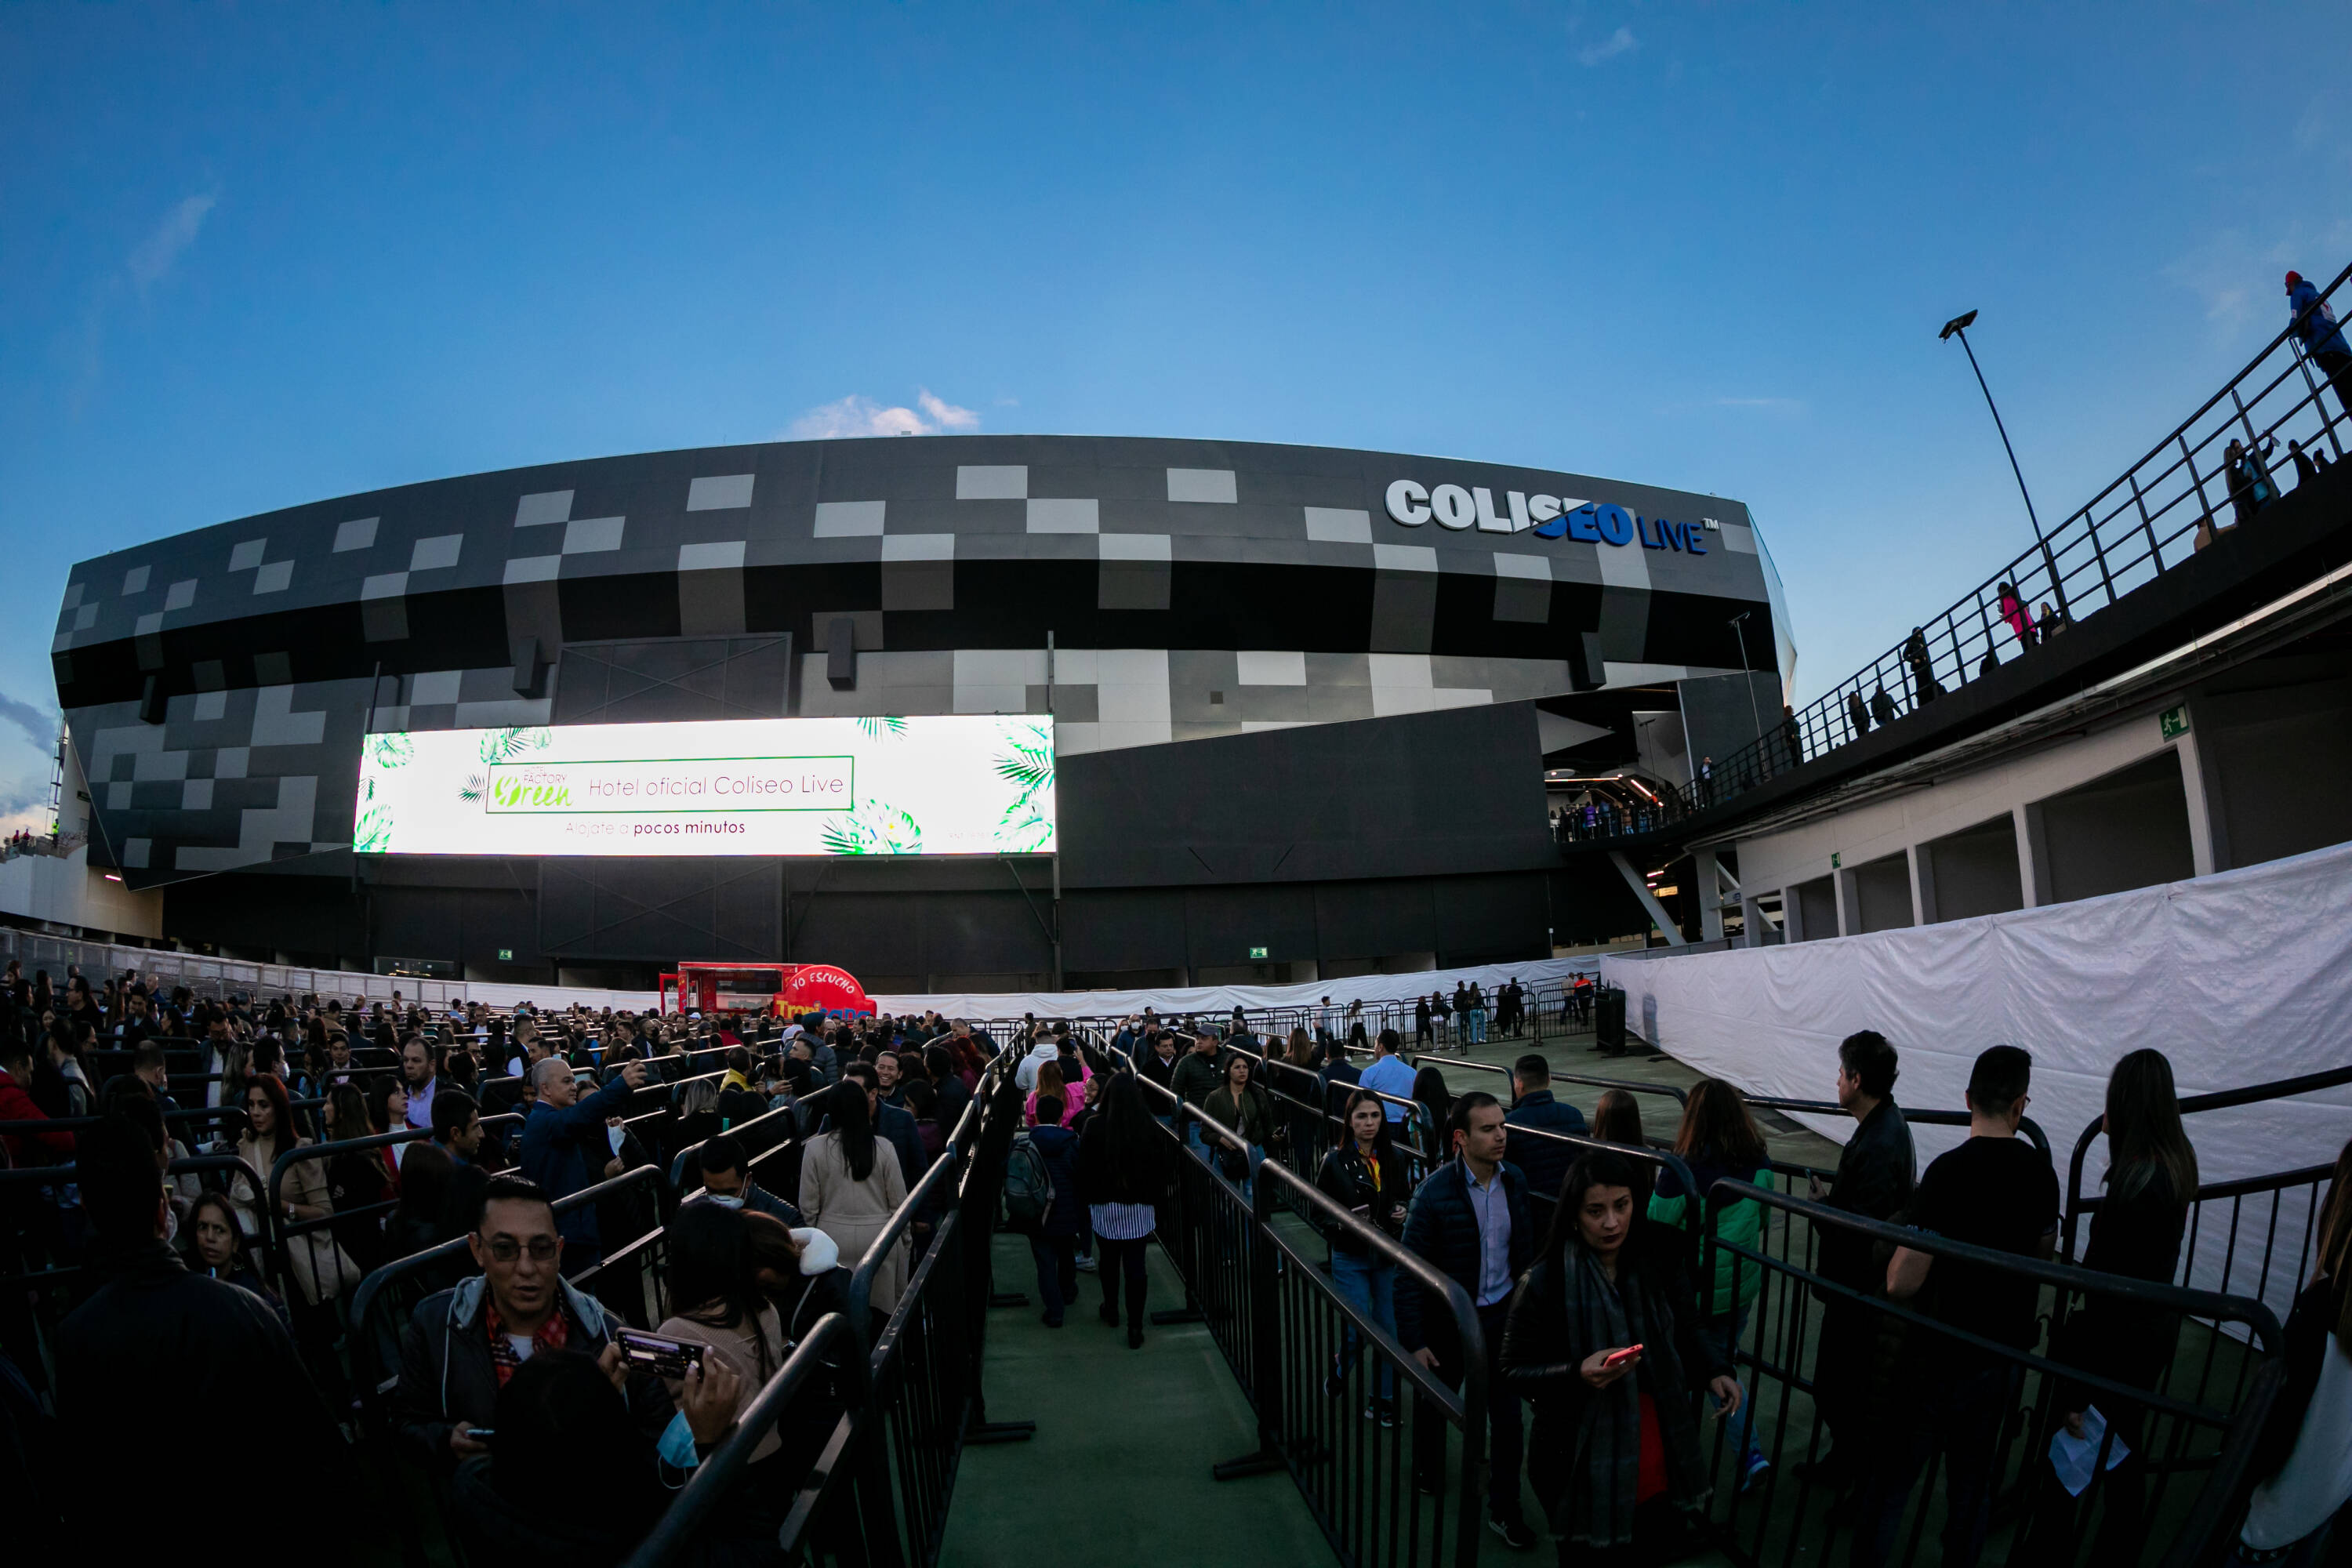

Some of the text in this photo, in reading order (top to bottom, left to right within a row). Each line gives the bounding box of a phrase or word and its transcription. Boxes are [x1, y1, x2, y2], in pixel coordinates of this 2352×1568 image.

[1385, 479, 1634, 547] COLISEO
[1636, 515, 1708, 555] LIVE
[523, 774, 568, 784] FACTORY
[589, 774, 844, 797] Hotel oficial Coliseo Live
[494, 775, 574, 808] Green
[619, 823, 629, 834] a
[633, 822, 680, 838] pocos
[685, 819, 746, 834] minutos
[792, 972, 855, 994] YO ESCUCHO
